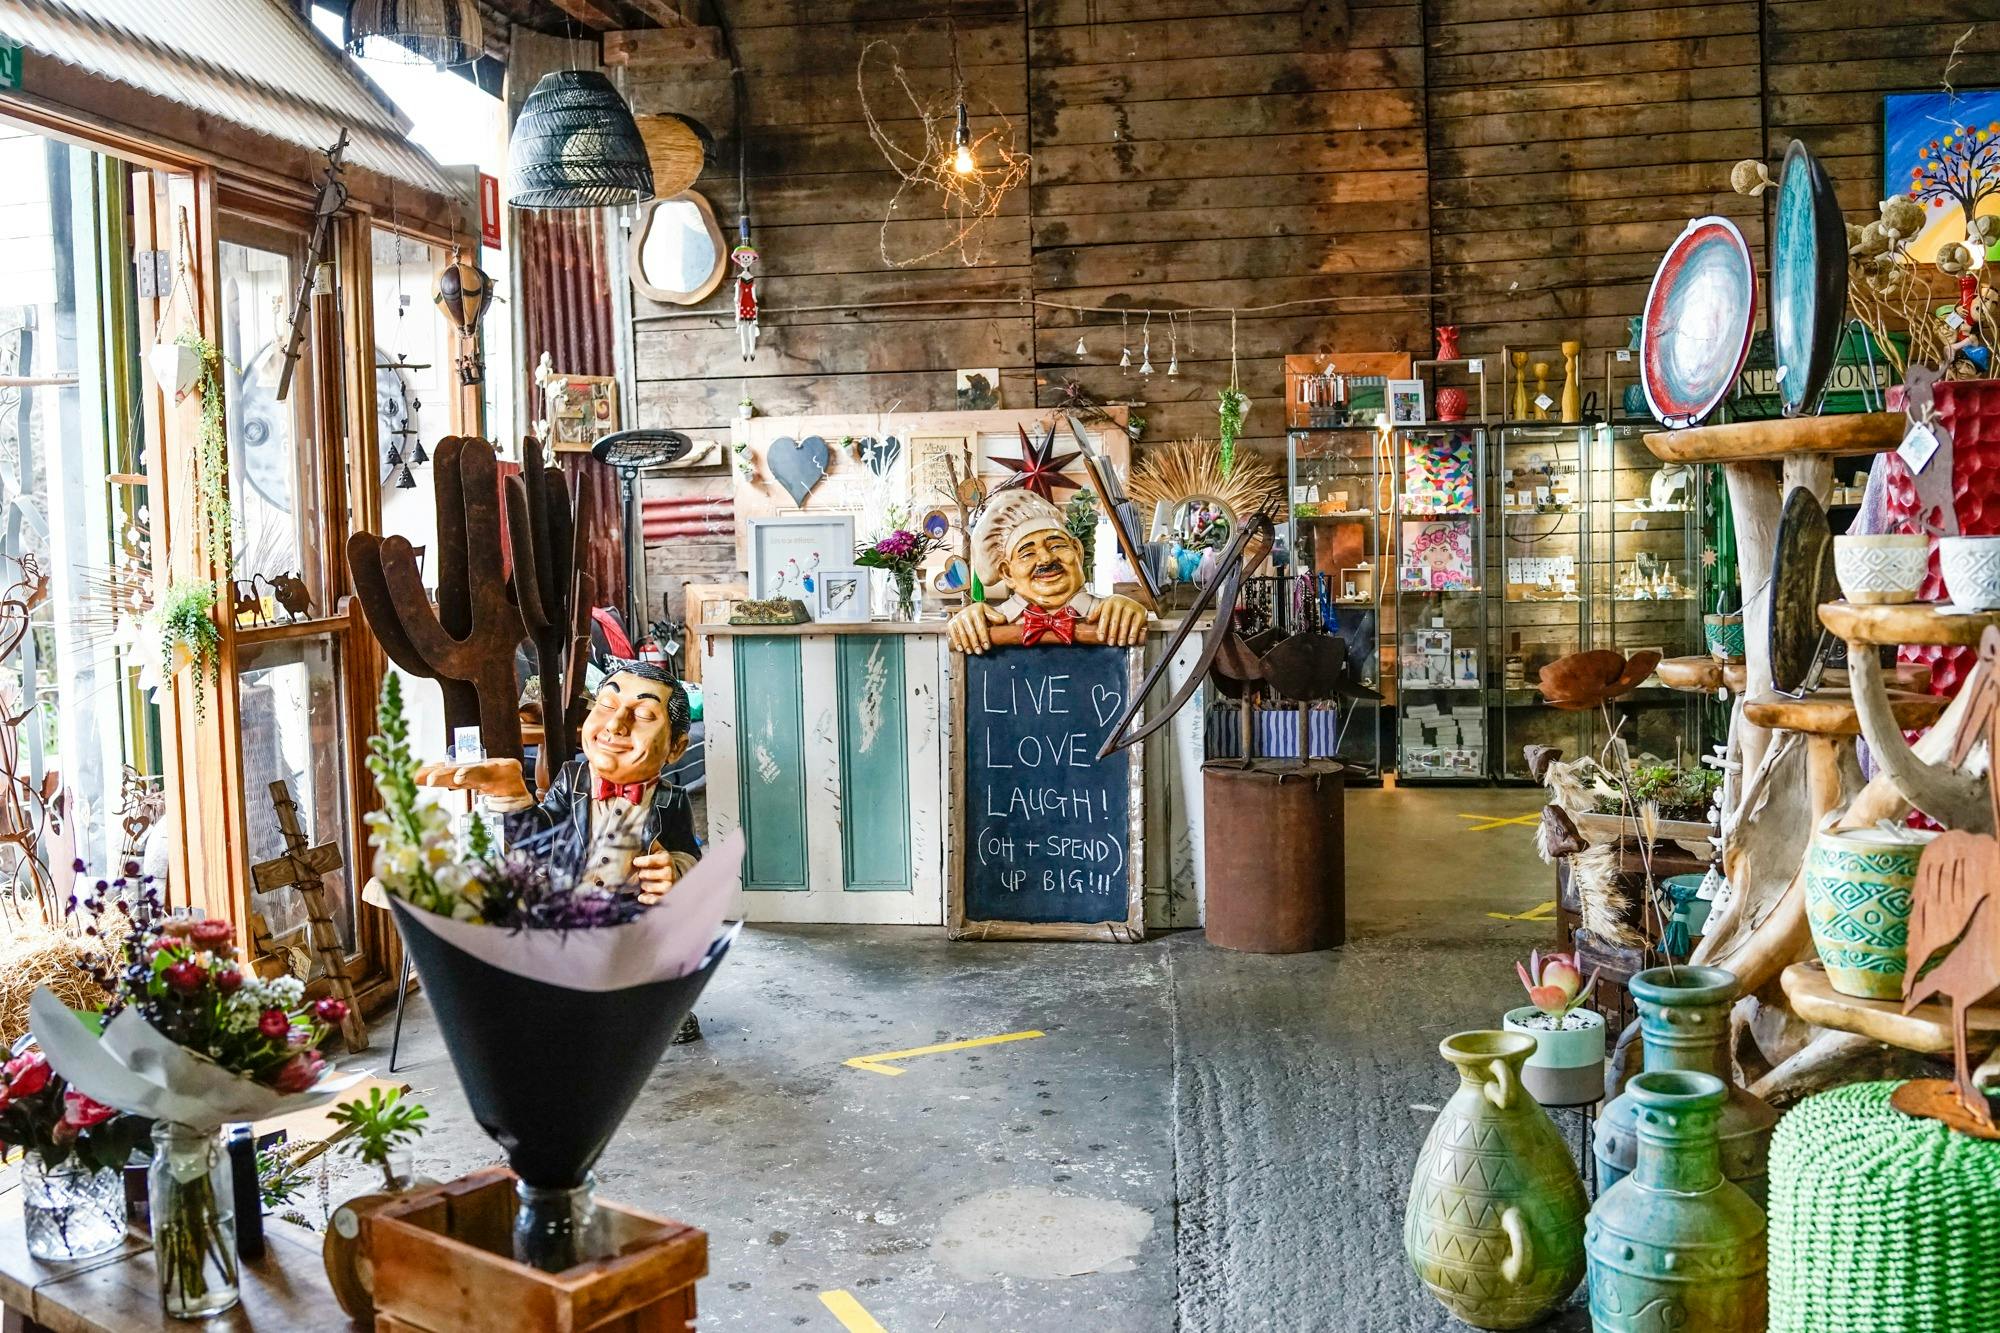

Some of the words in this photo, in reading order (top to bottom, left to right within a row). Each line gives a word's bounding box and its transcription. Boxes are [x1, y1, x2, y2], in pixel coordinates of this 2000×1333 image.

[1745, 365, 1886, 392] TEONE
[986, 726, 1092, 769] LOVE
[987, 784, 1110, 823] LAUGH!
[977, 826, 1015, 866] (OH
[1025, 840, 1040, 856] +
[1046, 832, 1123, 876] SPEND)
[1000, 869, 1026, 892] UP
[1043, 868, 1111, 896] BIG!!!
